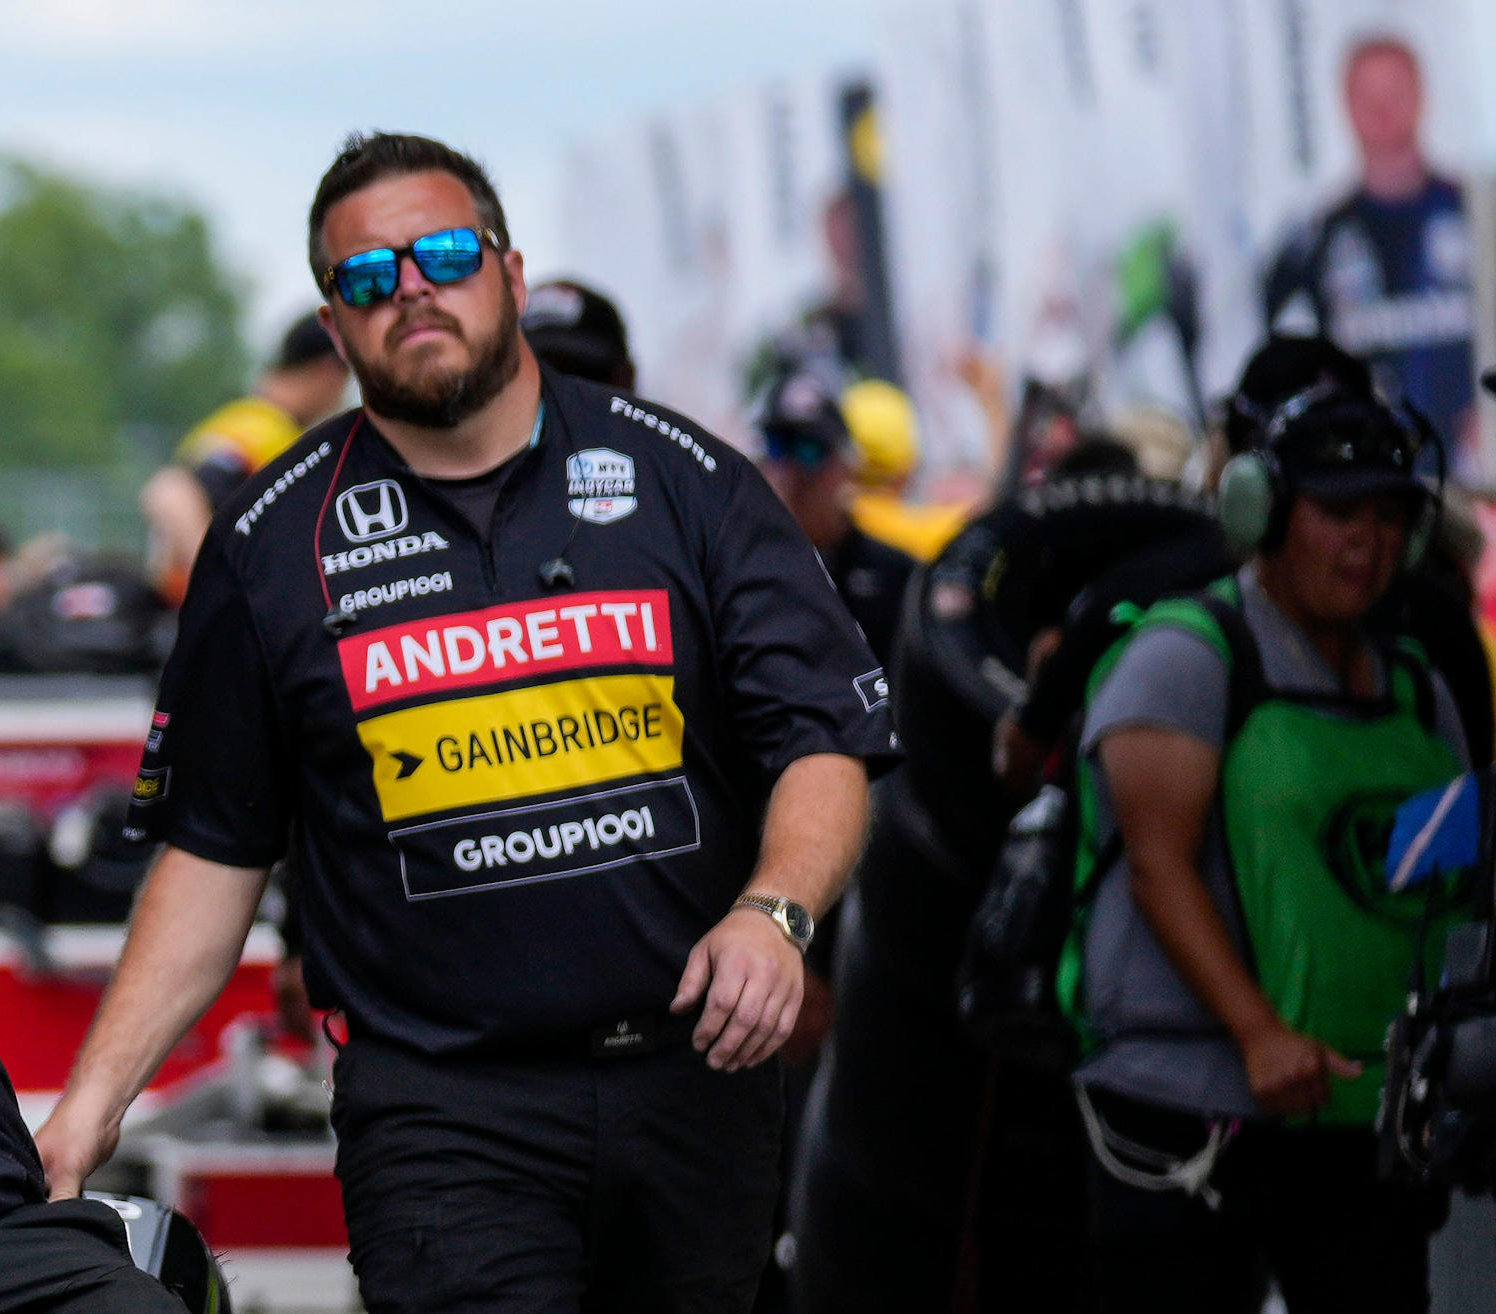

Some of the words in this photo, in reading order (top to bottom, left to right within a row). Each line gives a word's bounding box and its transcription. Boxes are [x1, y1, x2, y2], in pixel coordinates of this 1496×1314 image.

[610, 396, 717, 472] Firestone
[234, 441, 331, 536] Firestone
[321, 531, 450, 575] HONDA
[339, 571, 453, 614] GROUP1001
[365, 602, 657, 693] ANDRETTI
[435, 703, 662, 772] GAINBRIDGE
[453, 806, 655, 871] GROUP1001
